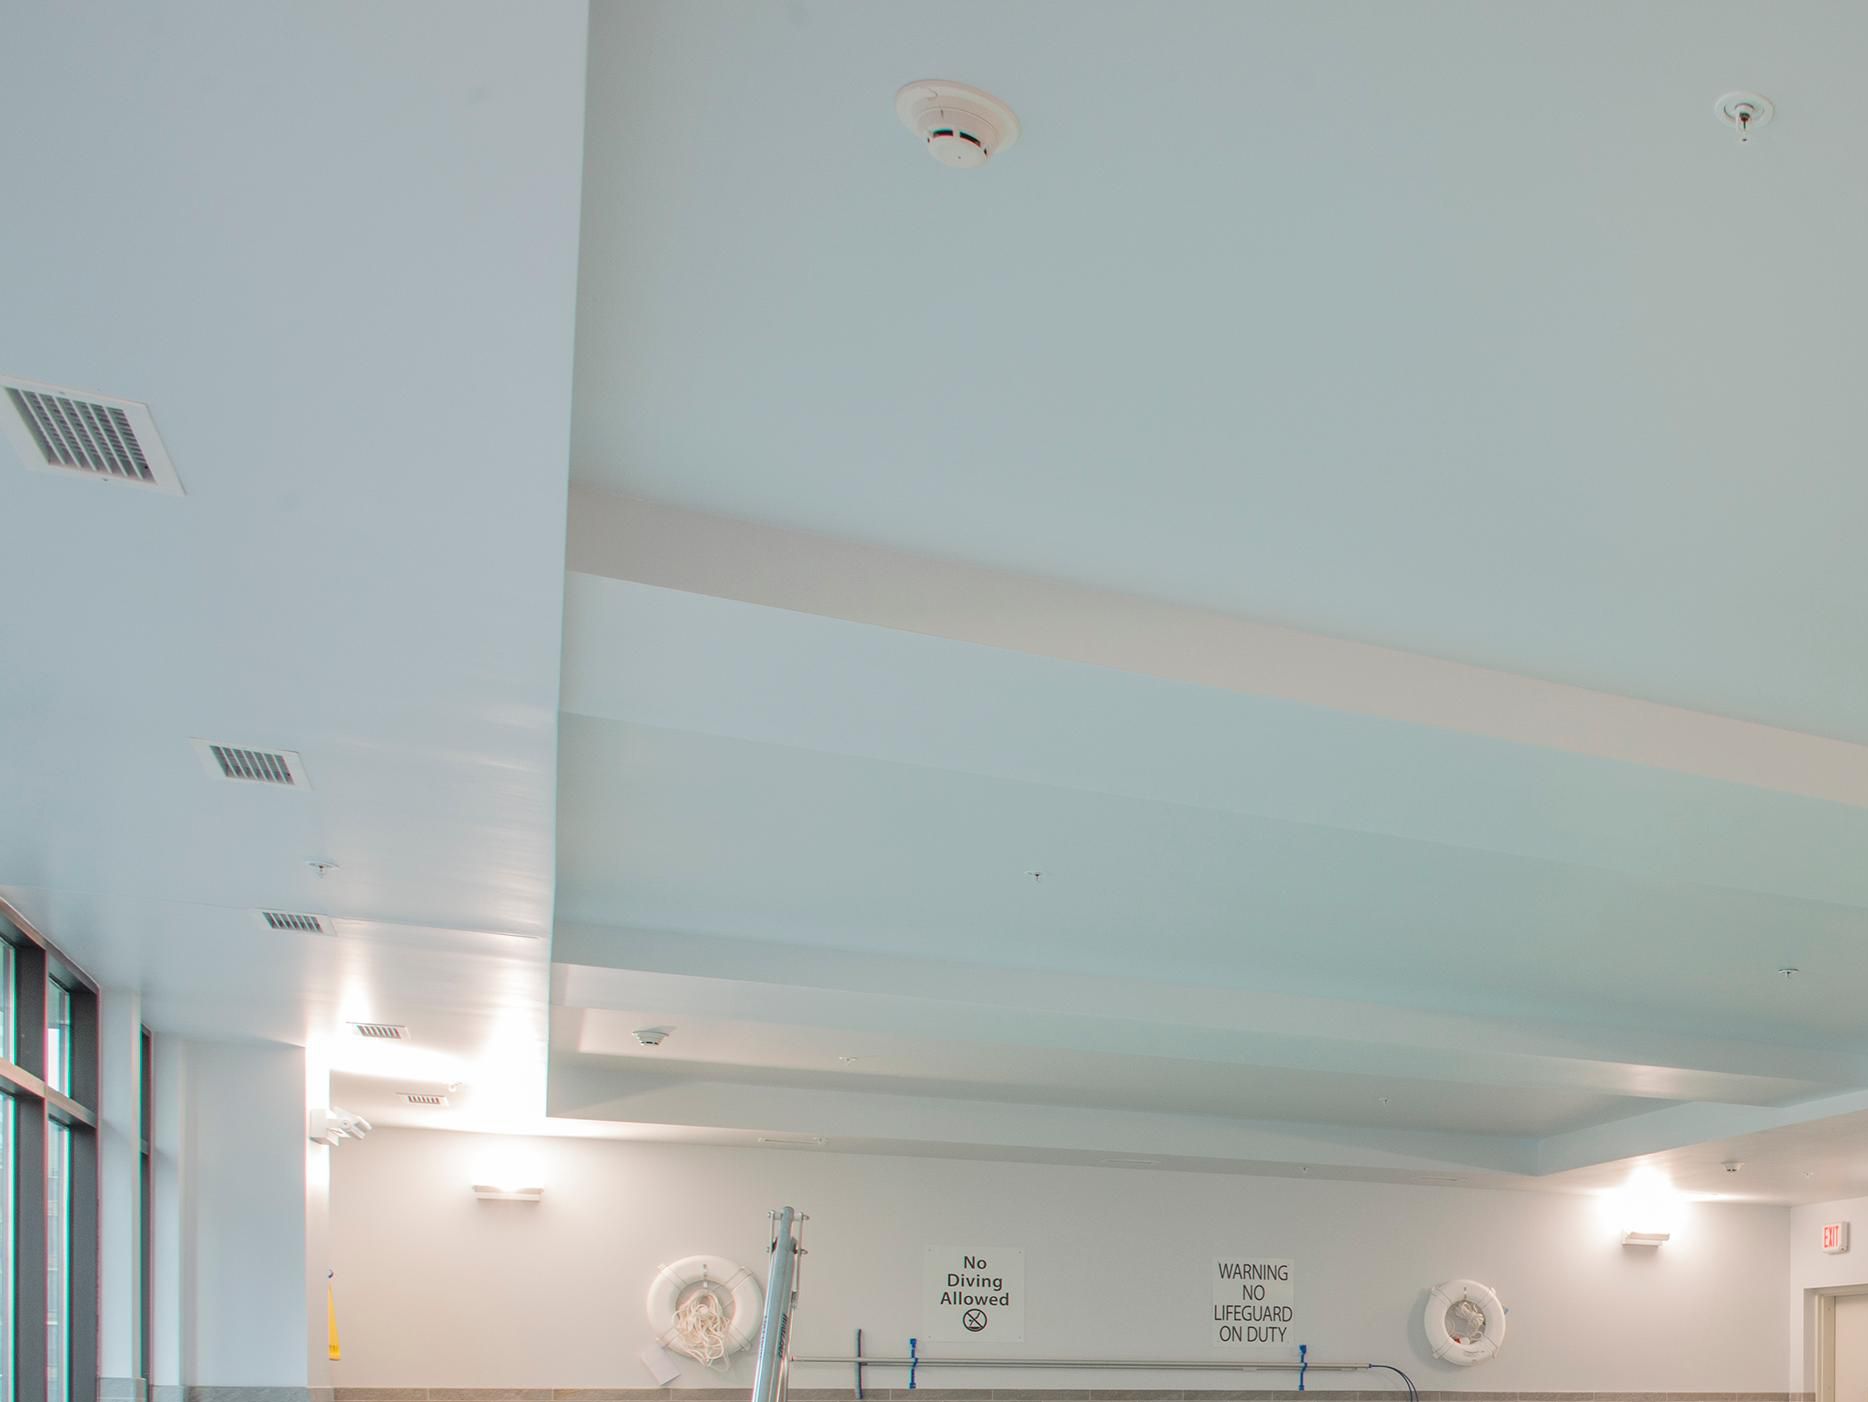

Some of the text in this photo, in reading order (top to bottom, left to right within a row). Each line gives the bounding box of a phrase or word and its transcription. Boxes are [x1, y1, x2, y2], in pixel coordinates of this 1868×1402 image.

[1823, 1225, 1840, 1248] EXIT
[964, 1255, 987, 1270] No
[1218, 1263, 1289, 1281] WARNING
[947, 1273, 1003, 1292] Diving
[940, 1291, 1009, 1306] Allowed
[1242, 1284, 1266, 1301] NO
[1213, 1304, 1293, 1322] LIFEGUARD
[1219, 1325, 1288, 1343] ON DUTY
